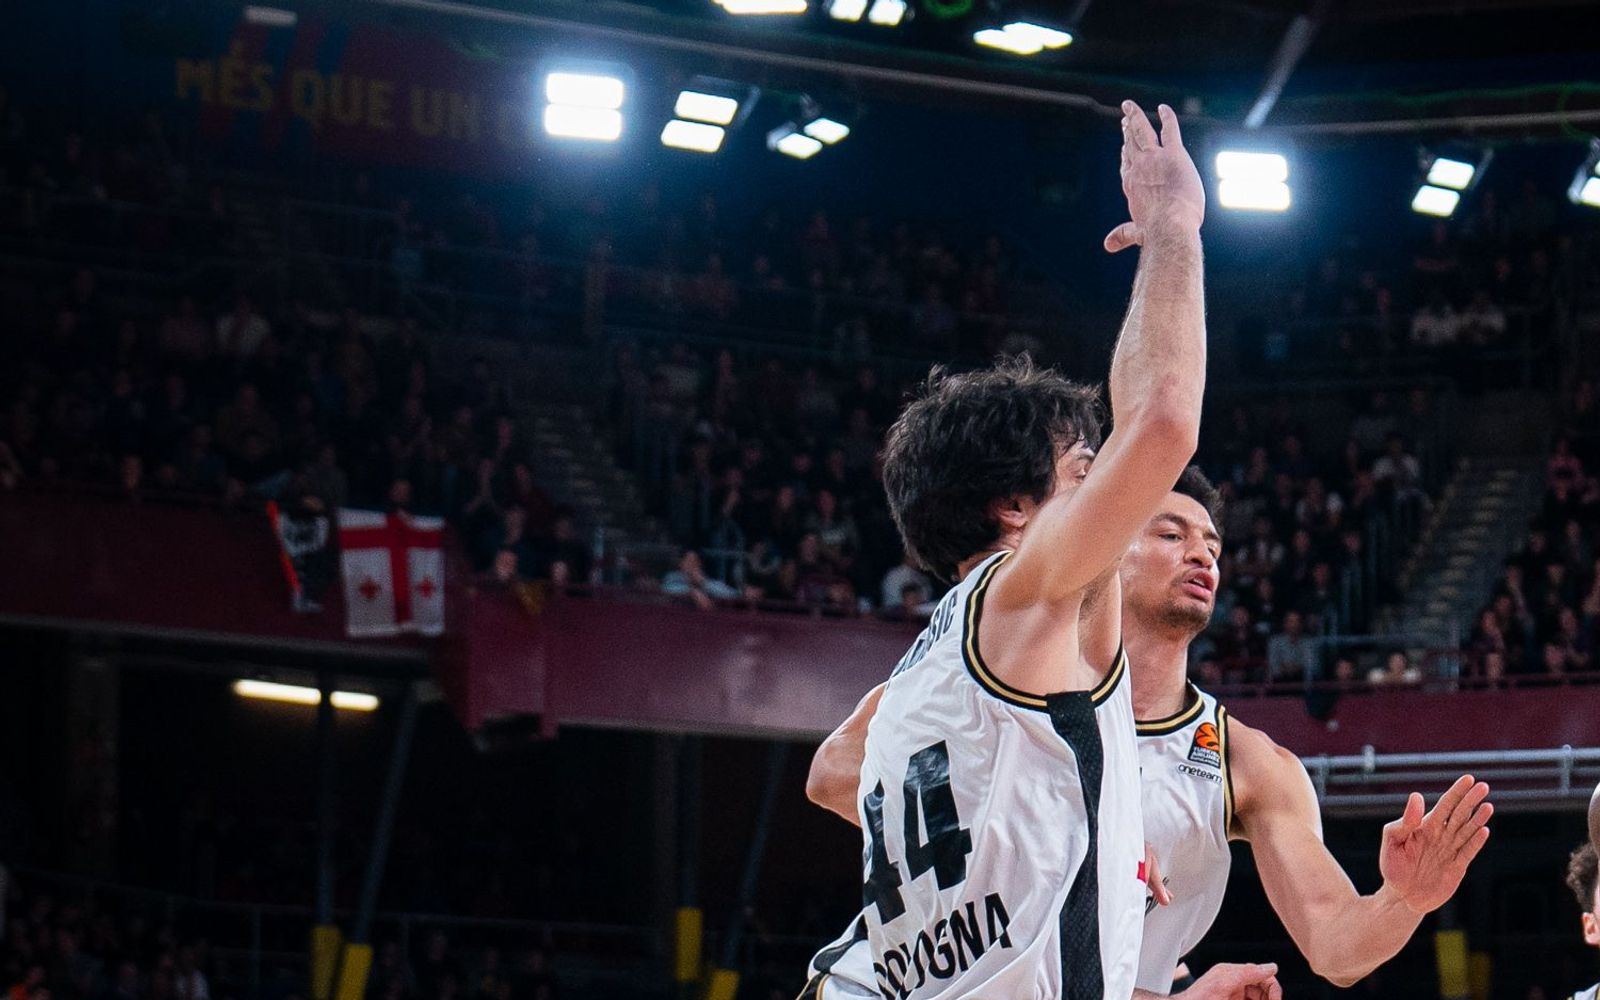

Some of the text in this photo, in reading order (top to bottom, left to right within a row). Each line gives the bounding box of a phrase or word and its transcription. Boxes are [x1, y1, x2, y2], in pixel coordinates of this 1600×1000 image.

[291, 69, 398, 130] QUE
[411, 87, 481, 140] UN
[1178, 764, 1222, 782] oneteam
